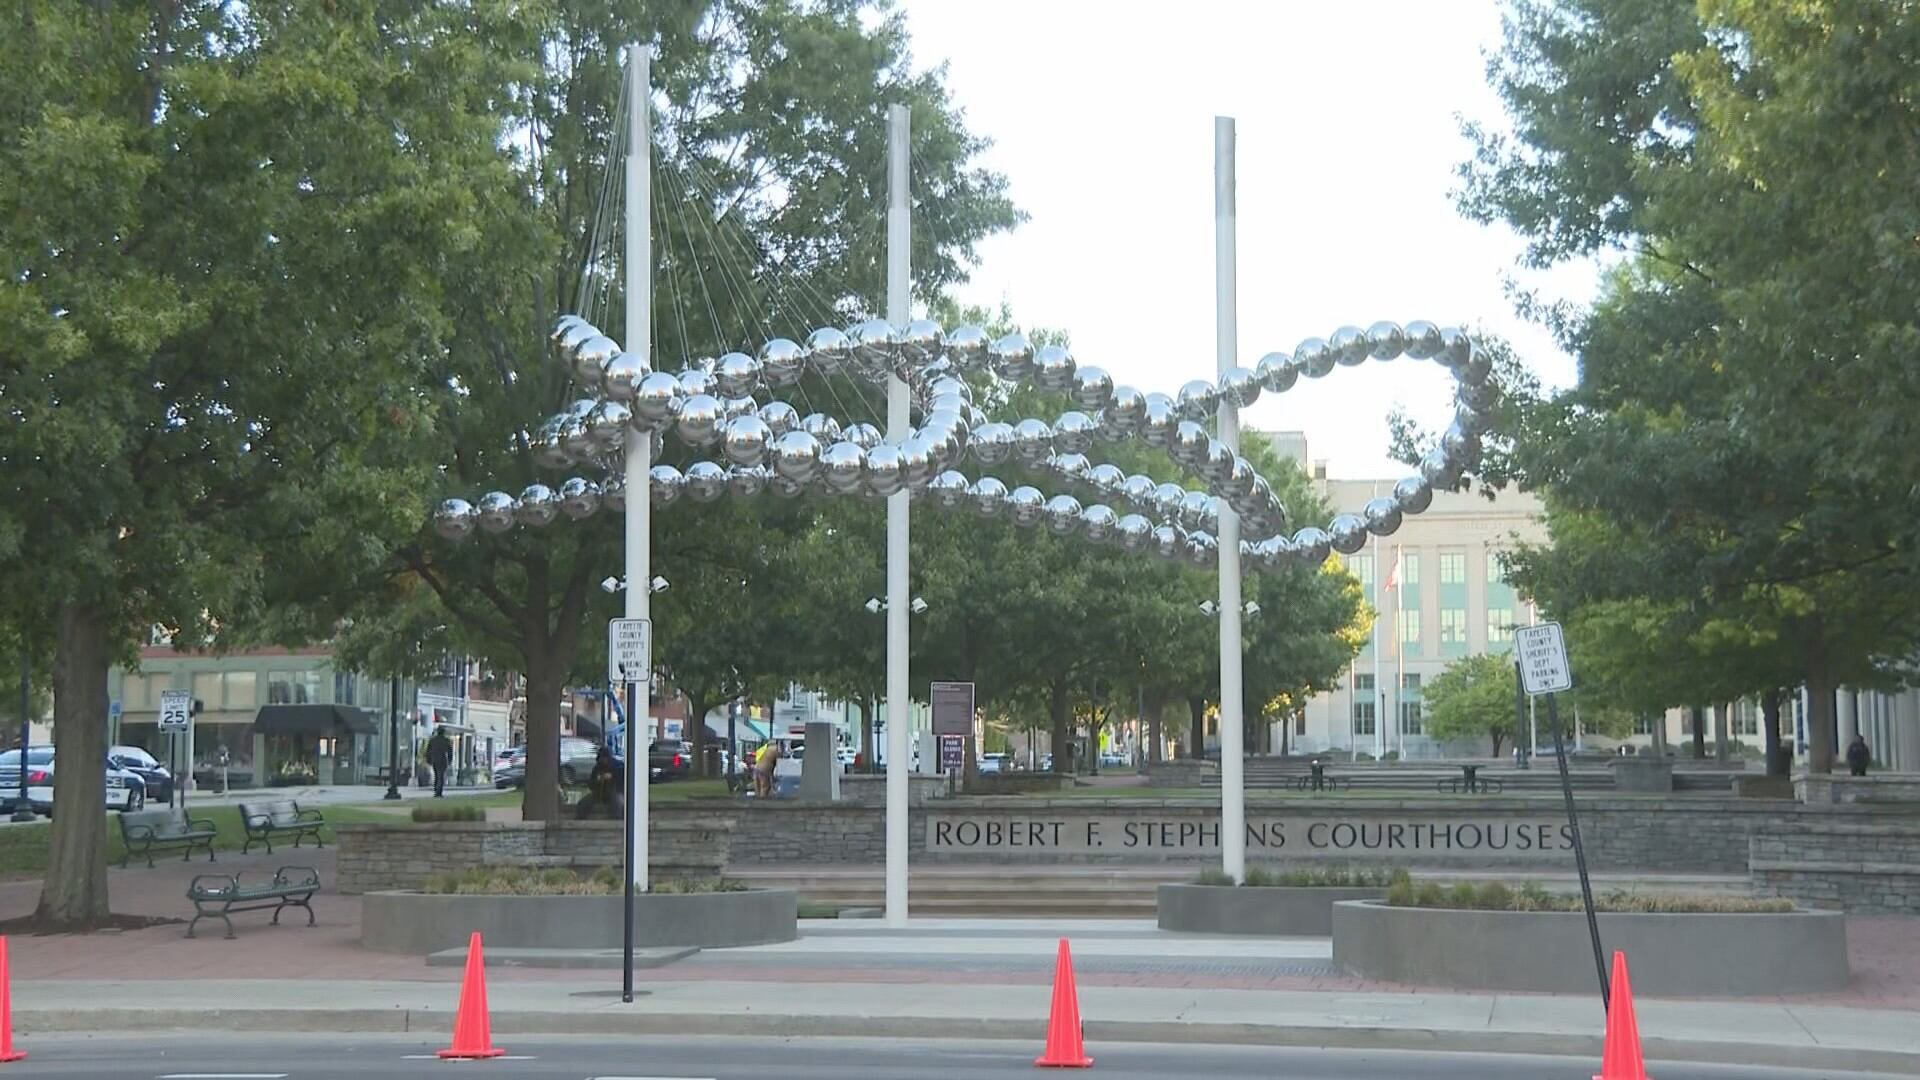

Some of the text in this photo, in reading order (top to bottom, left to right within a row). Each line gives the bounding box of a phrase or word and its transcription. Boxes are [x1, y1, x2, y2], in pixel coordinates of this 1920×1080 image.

[1525, 627, 1551, 638] FAYETTE
[1527, 637, 1552, 648] COUNTY
[1526, 646, 1558, 658] SHERIFF'S
[1531, 668, 1559, 678] PARKING
[1539, 679, 1554, 688] ONLY
[164, 710, 185, 724] 25
[935, 821, 1575, 850] ROBERT F. STEPHNS COURTHOUSES
